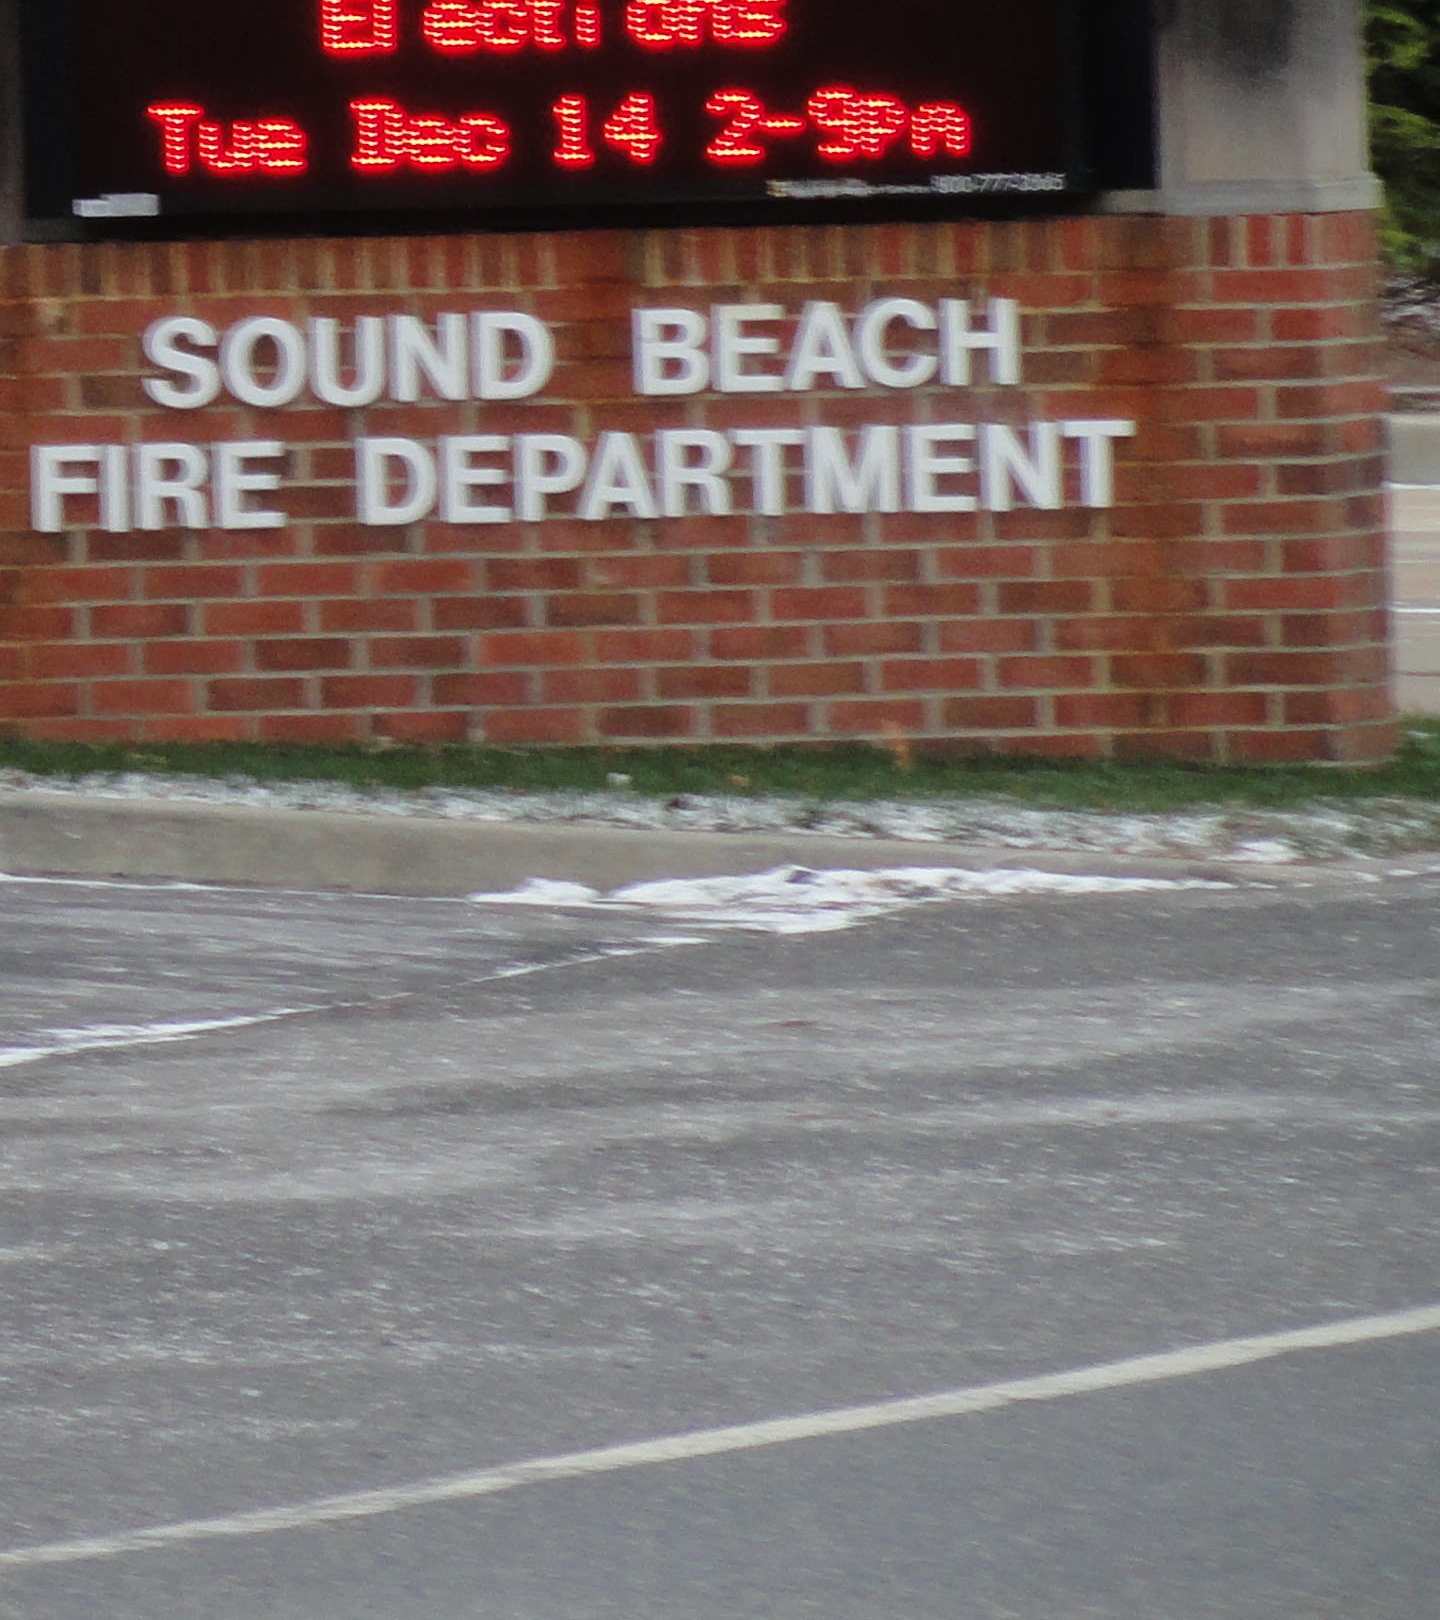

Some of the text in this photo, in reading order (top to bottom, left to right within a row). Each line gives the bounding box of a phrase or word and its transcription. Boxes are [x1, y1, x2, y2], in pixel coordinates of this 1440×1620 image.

[146, 102, 308, 170] Tue
[349, 97, 510, 168] Dec
[553, 93, 662, 165] 14
[143, 297, 1022, 412] SOUND BEACH
[30, 418, 1136, 534] FIRE DEPARTMENT
